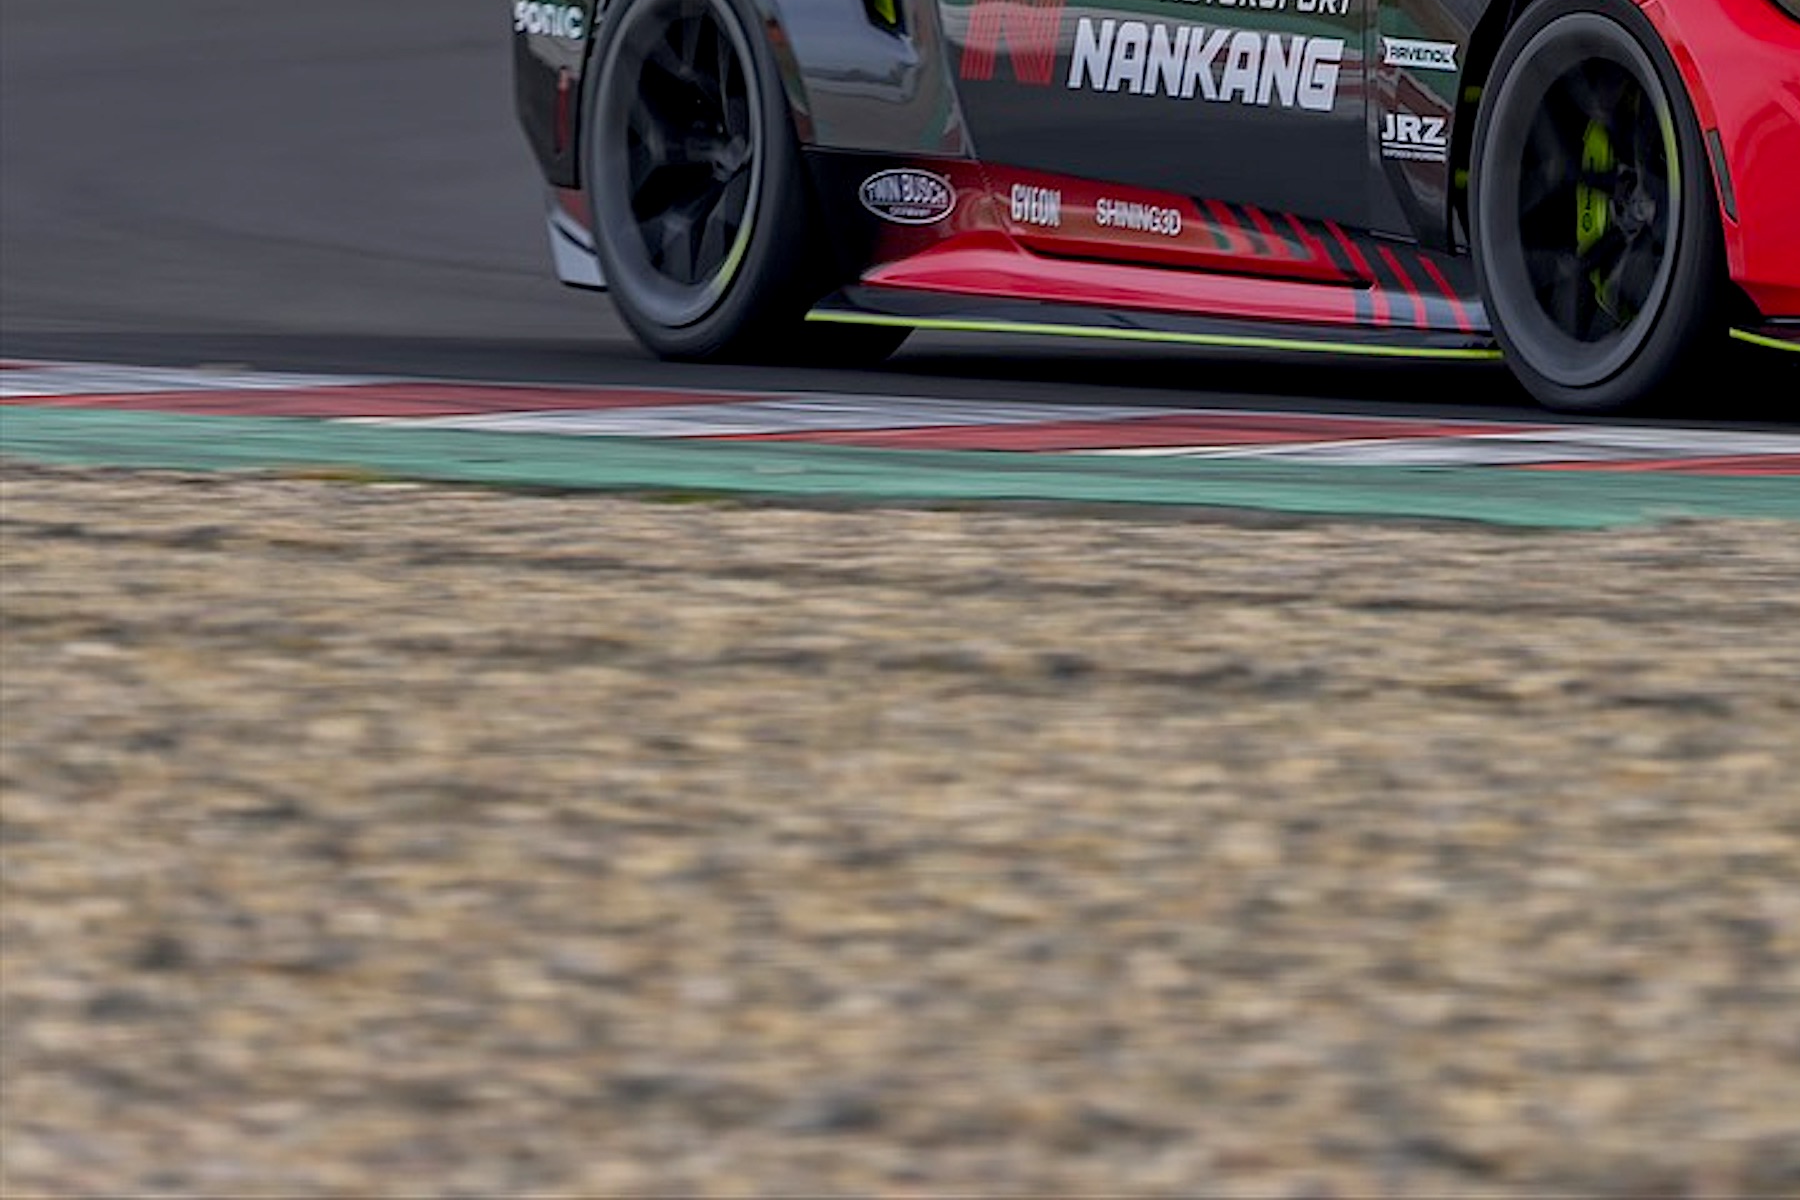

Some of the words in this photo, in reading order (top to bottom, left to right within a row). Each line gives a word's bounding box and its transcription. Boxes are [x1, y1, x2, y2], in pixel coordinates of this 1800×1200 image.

[1067, 17, 1345, 112] NANKANG
[1382, 113, 1446, 145] JRZ
[867, 175, 901, 203] TWIN
[901, 174, 948, 204] BUSCH
[1096, 198, 1182, 236] SHINING3D
